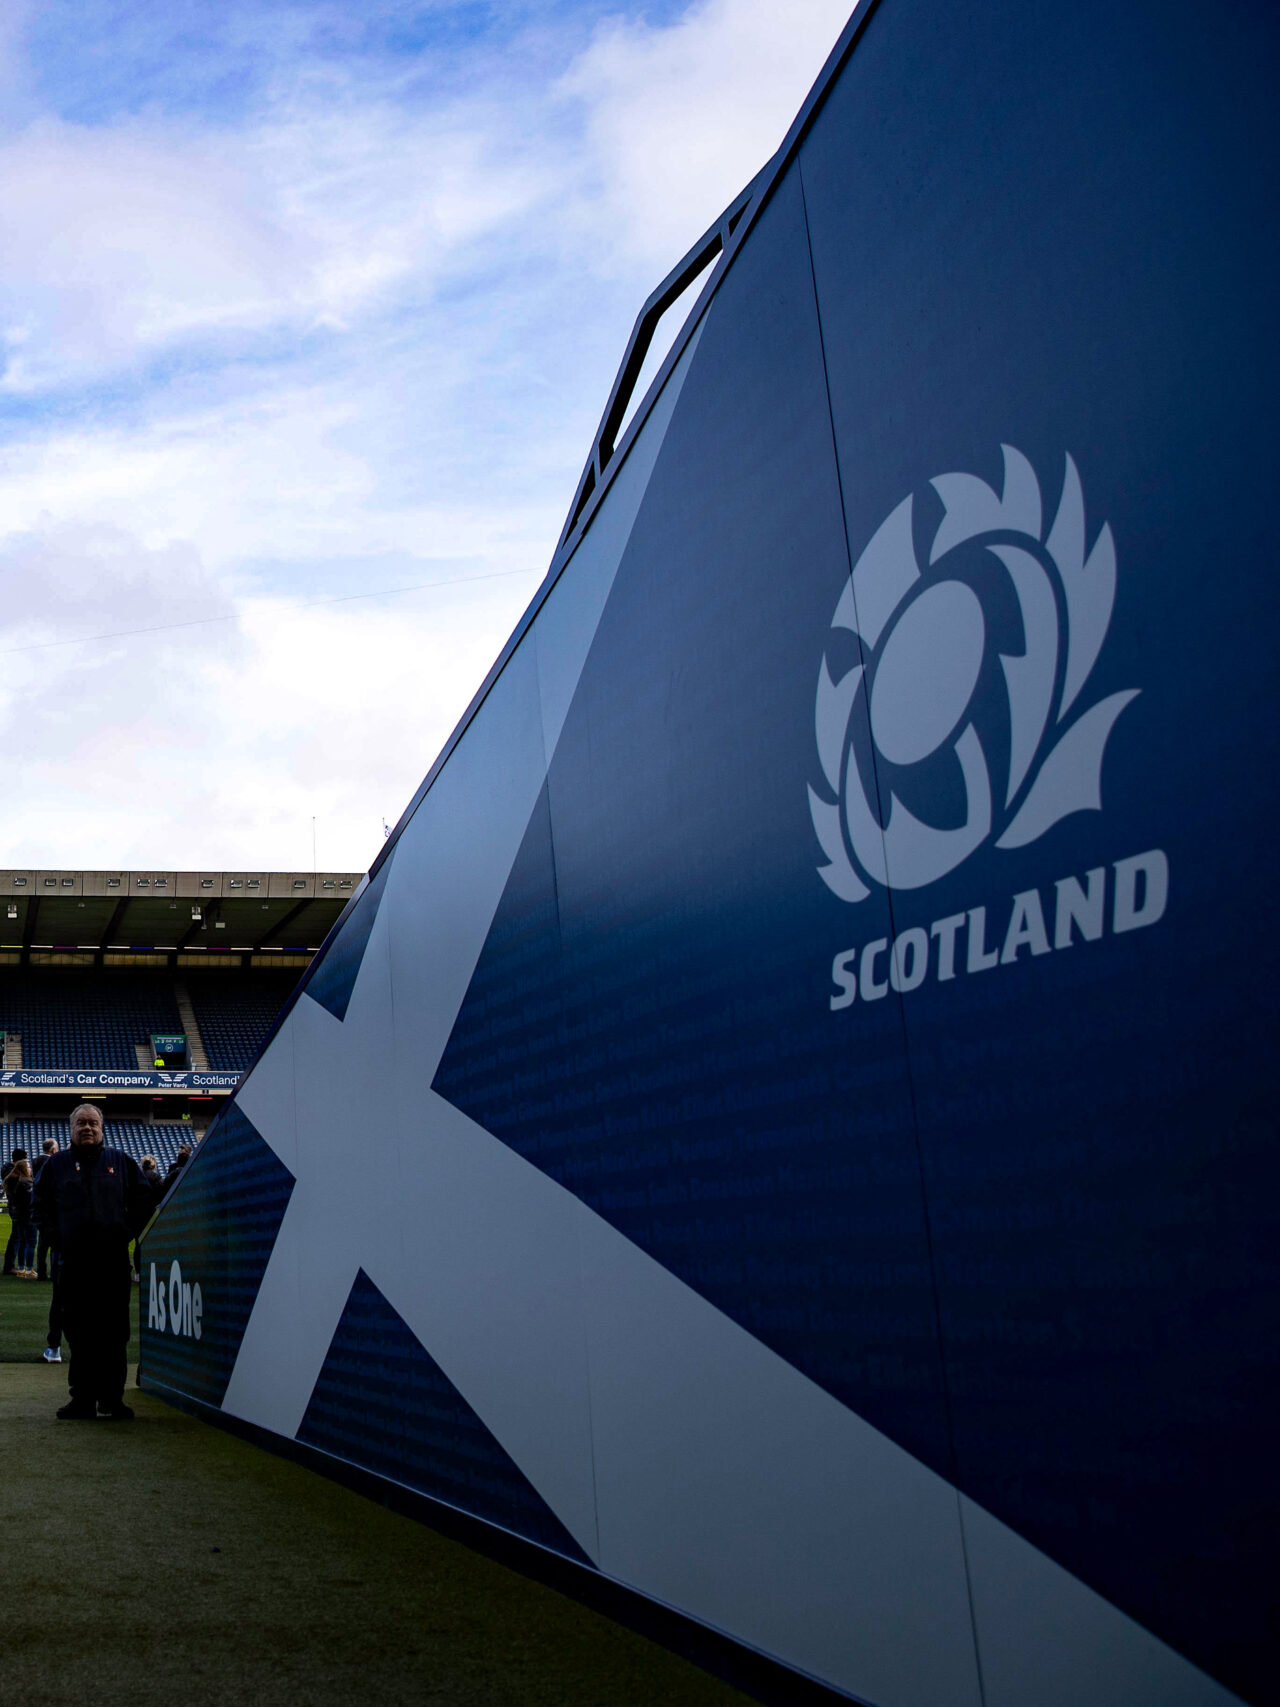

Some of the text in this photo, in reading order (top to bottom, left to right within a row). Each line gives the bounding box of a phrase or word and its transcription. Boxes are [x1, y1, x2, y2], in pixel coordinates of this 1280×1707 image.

[830, 849, 1169, 1011] SCOTLAND
[21, 1073, 153, 1088] Scotland's Car Company.
[192, 1075, 240, 1085] Scotland'
[148, 1260, 203, 1341] As One
